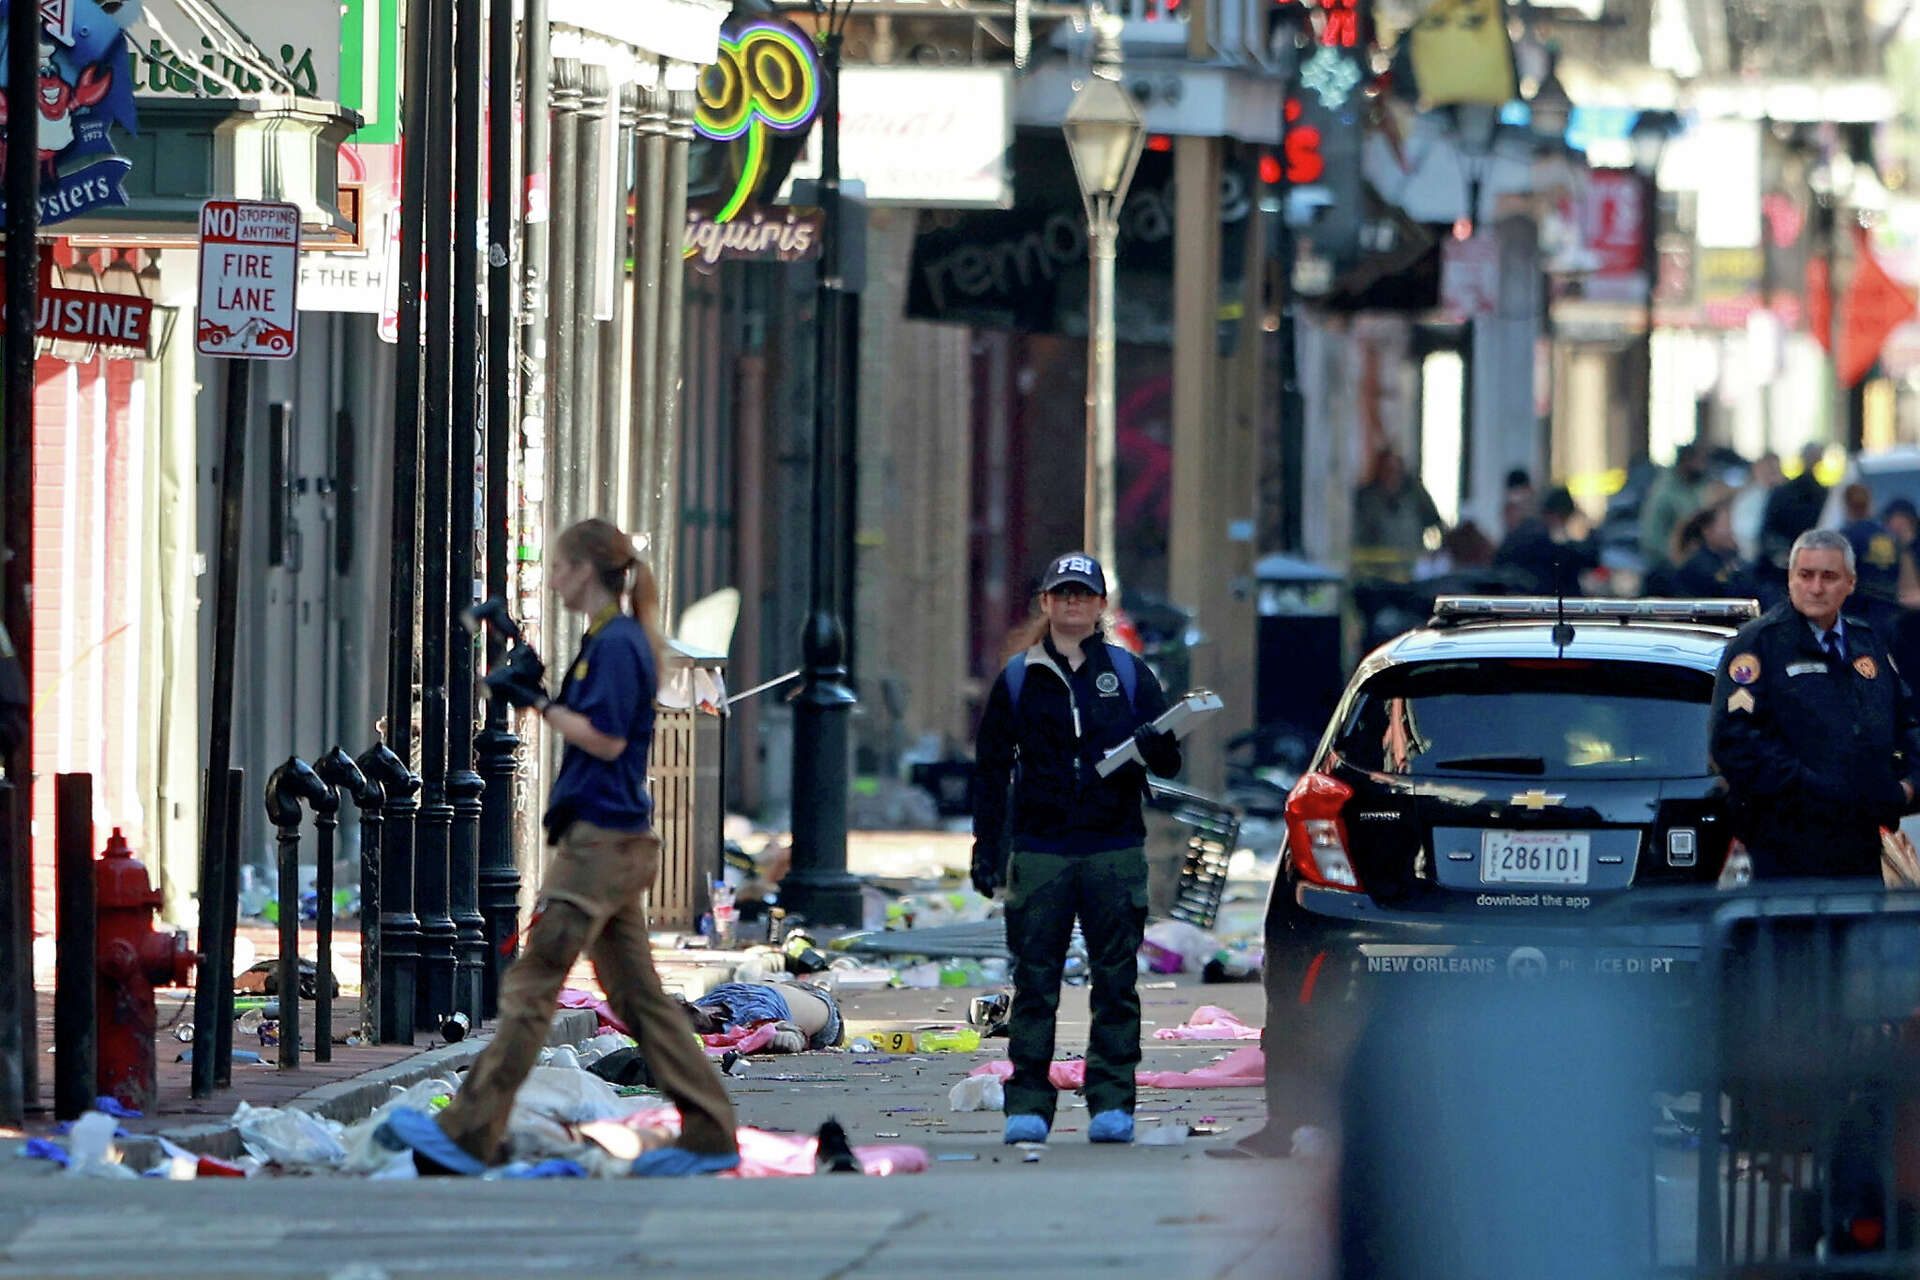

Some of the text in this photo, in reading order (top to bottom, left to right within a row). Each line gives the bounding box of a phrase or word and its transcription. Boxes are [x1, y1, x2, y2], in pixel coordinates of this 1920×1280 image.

[36, 177, 109, 225] ysters
[204, 208, 235, 237] NO
[238, 208, 297, 224] STOPPING
[242, 226, 291, 240] ANYTIME
[683, 210, 815, 263] iquiris
[223, 253, 273, 279] FIRE
[318, 269, 358, 287] THE
[217, 287, 276, 312] LANE
[33, 298, 143, 340] UISINE
[1057, 557, 1093, 575] FBI
[1502, 846, 1579, 871] 286101
[1476, 894, 1590, 909] download the app
[1367, 957, 1408, 973] NEW
[1412, 957, 1496, 973] ORLEANS
[892, 1033, 903, 1050] 9
